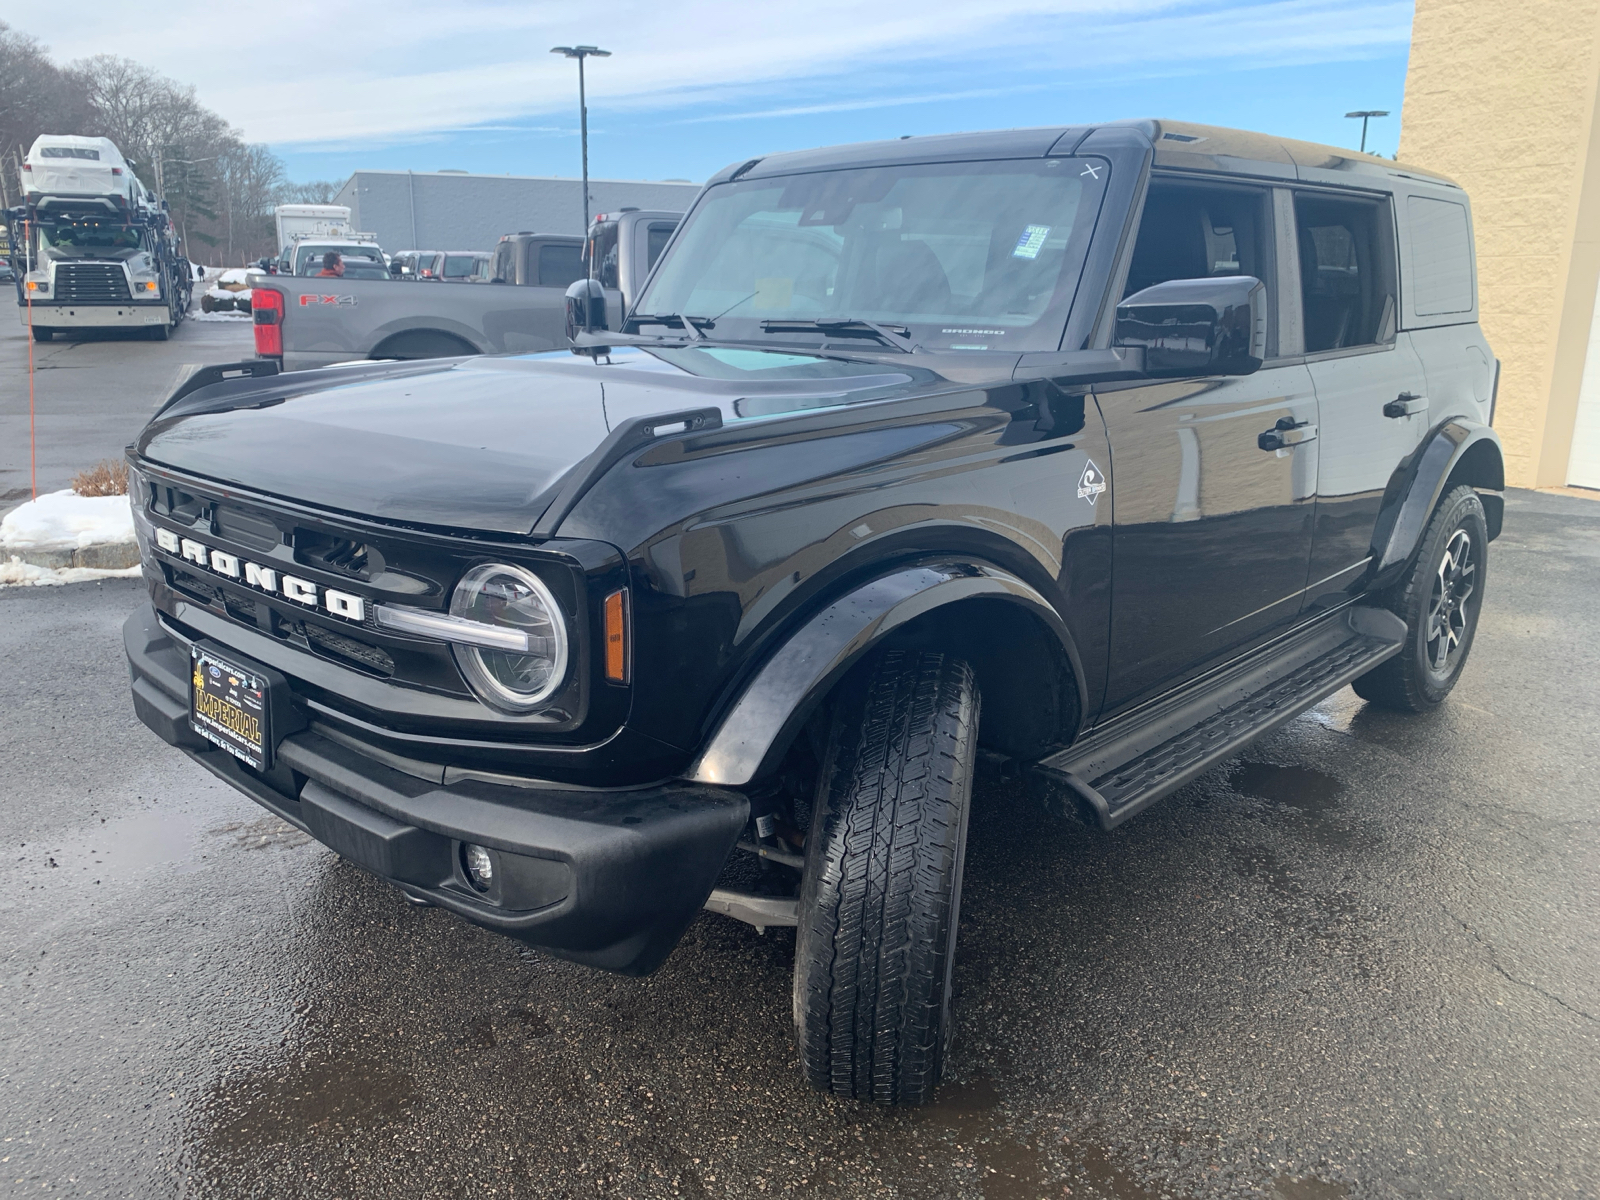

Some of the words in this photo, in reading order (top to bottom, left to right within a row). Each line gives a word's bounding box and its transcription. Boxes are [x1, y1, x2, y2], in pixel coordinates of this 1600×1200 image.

[299, 294, 358, 306] FX4
[157, 527, 365, 621] BRONCO
[196, 687, 262, 746] IMPERIAL
